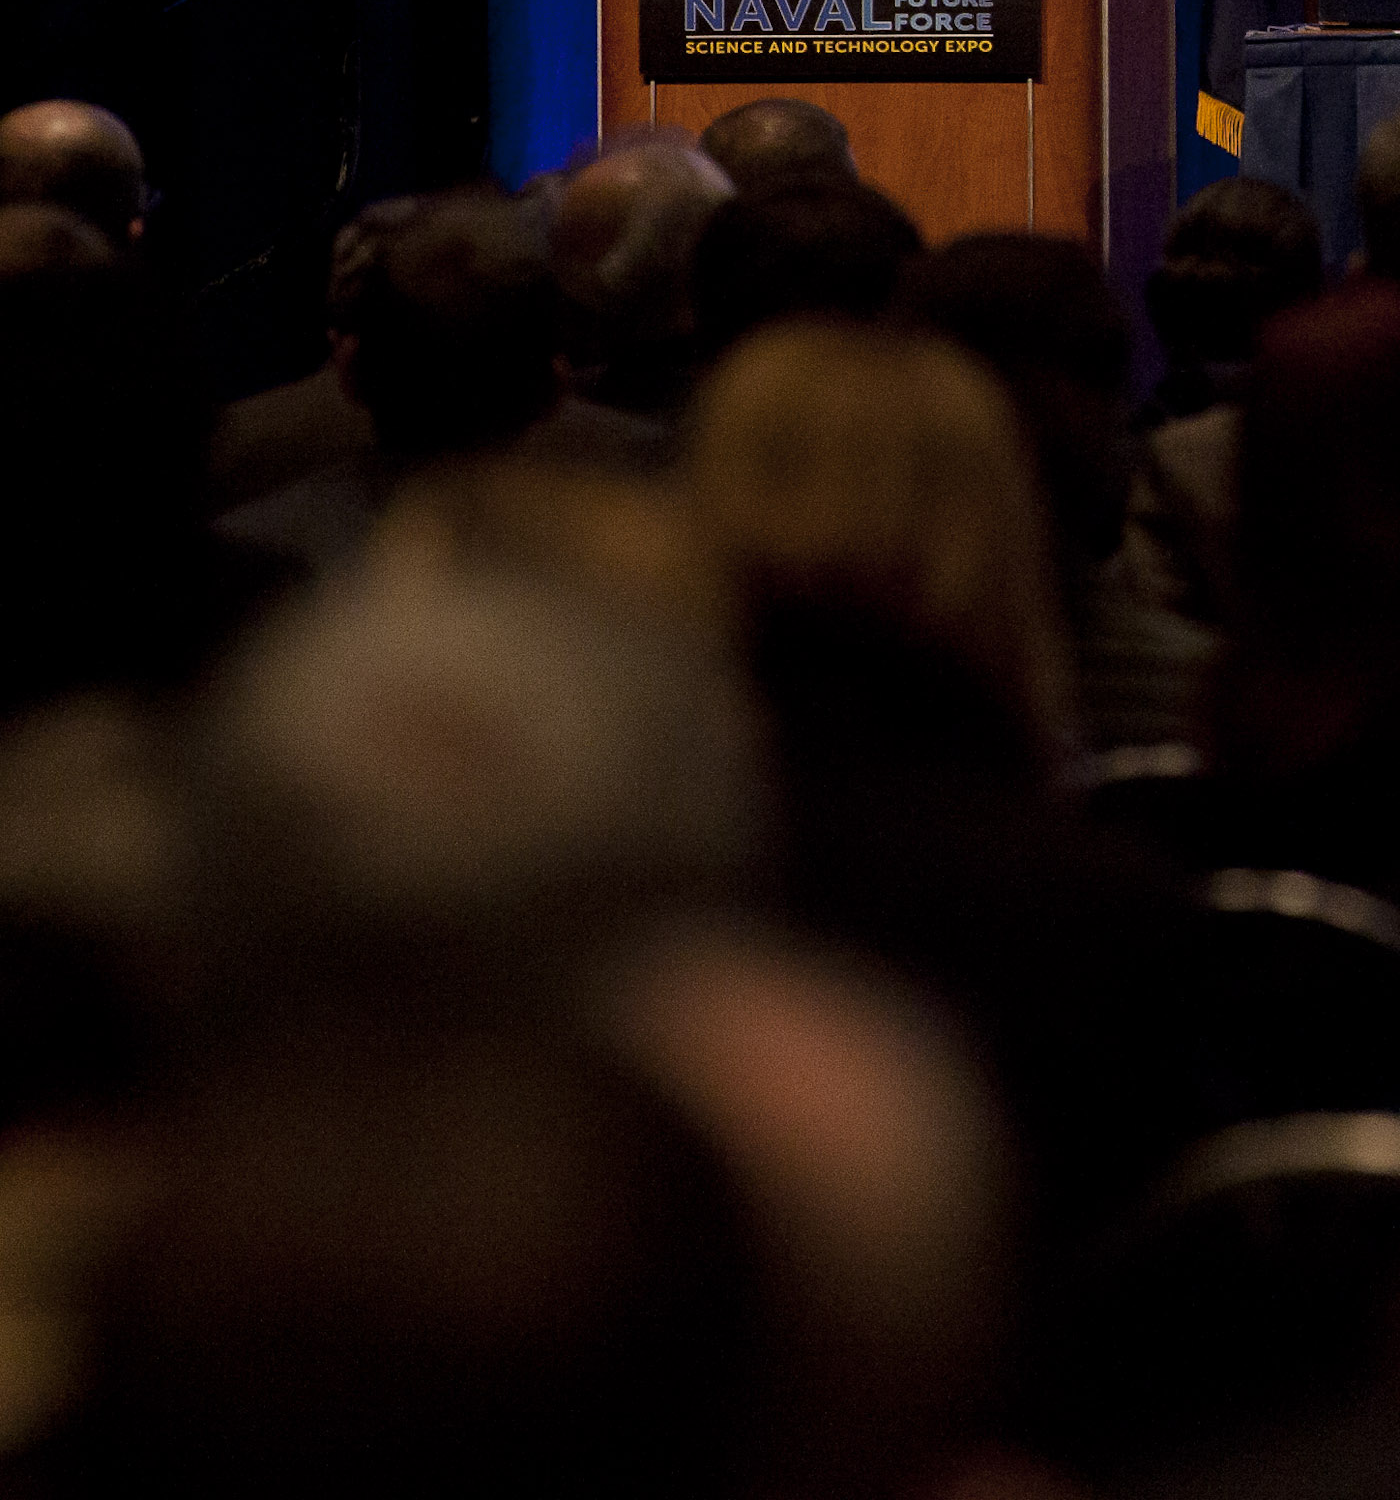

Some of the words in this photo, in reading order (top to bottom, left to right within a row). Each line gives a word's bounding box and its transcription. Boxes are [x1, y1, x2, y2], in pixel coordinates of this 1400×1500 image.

[895, 13, 992, 31] FORCE
[686, 40, 763, 54] SCIENCE
[768, 40, 807, 54] AND
[813, 40, 939, 54] TECHNOLOGY
[945, 40, 992, 53] EXPO
